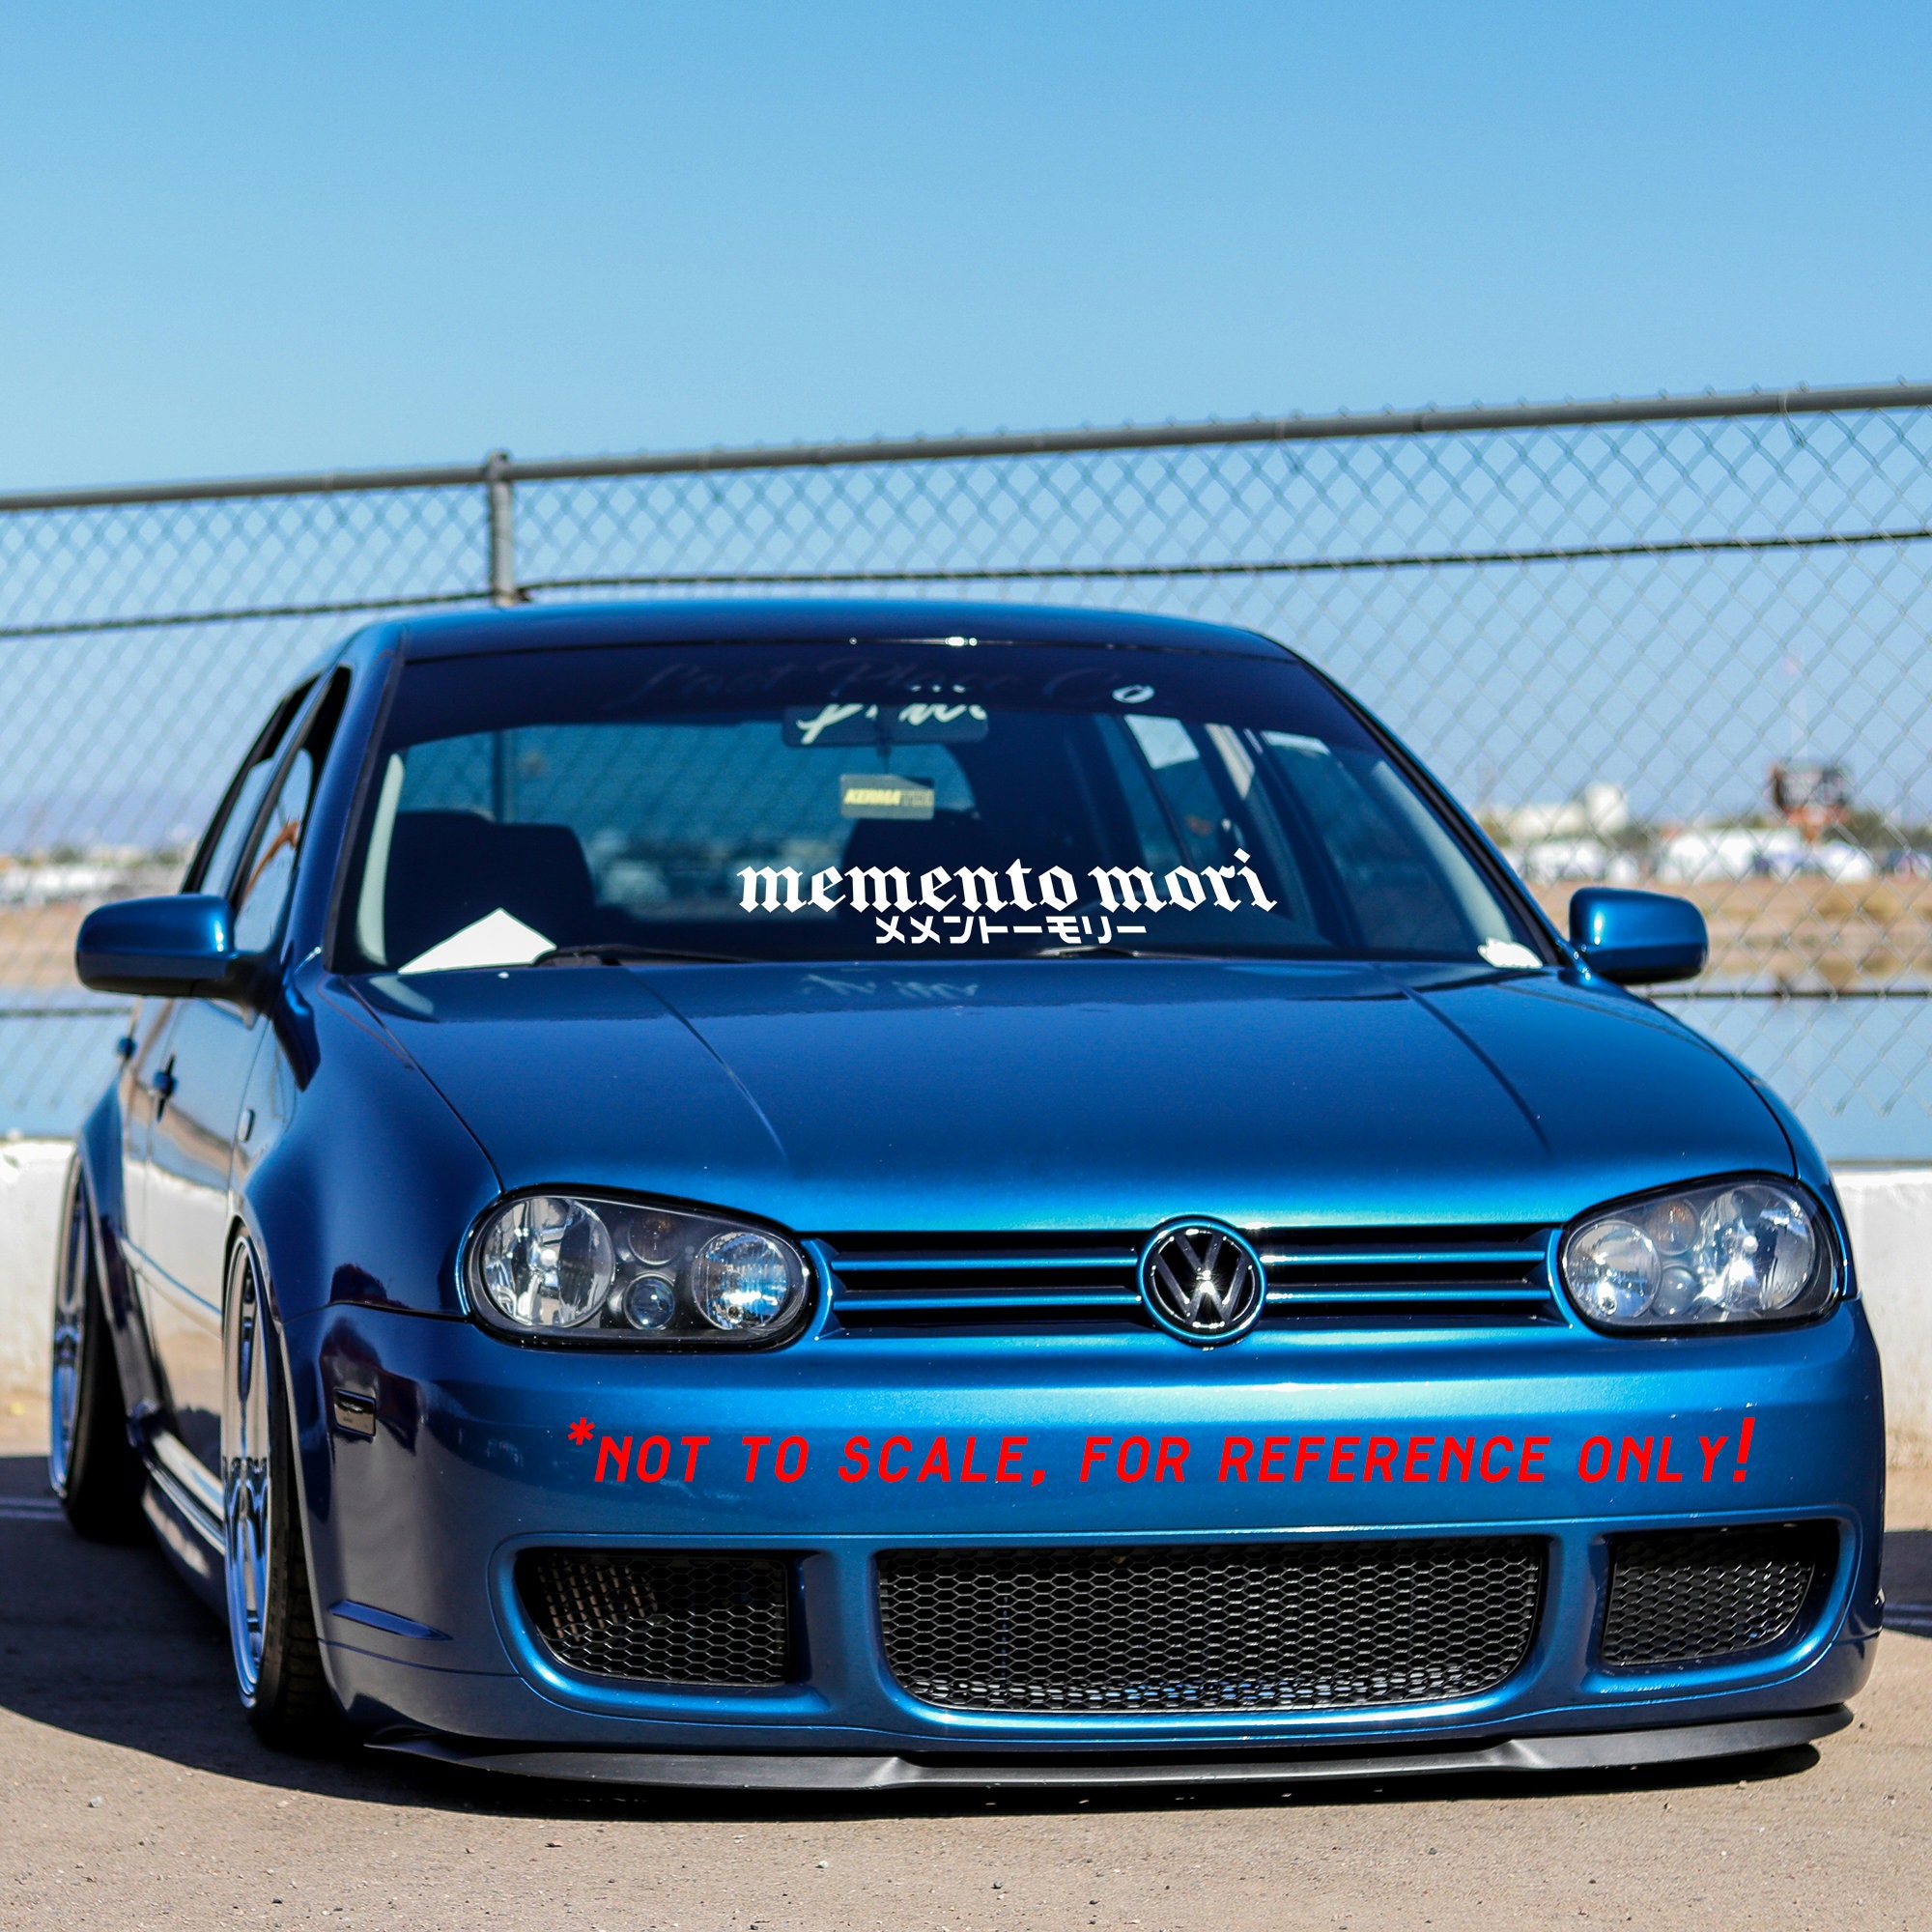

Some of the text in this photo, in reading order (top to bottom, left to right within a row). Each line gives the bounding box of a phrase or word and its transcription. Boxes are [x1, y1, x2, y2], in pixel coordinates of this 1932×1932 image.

[736, 847, 1278, 913] memento mori
[875, 916, 1147, 944] メメントーモリー
